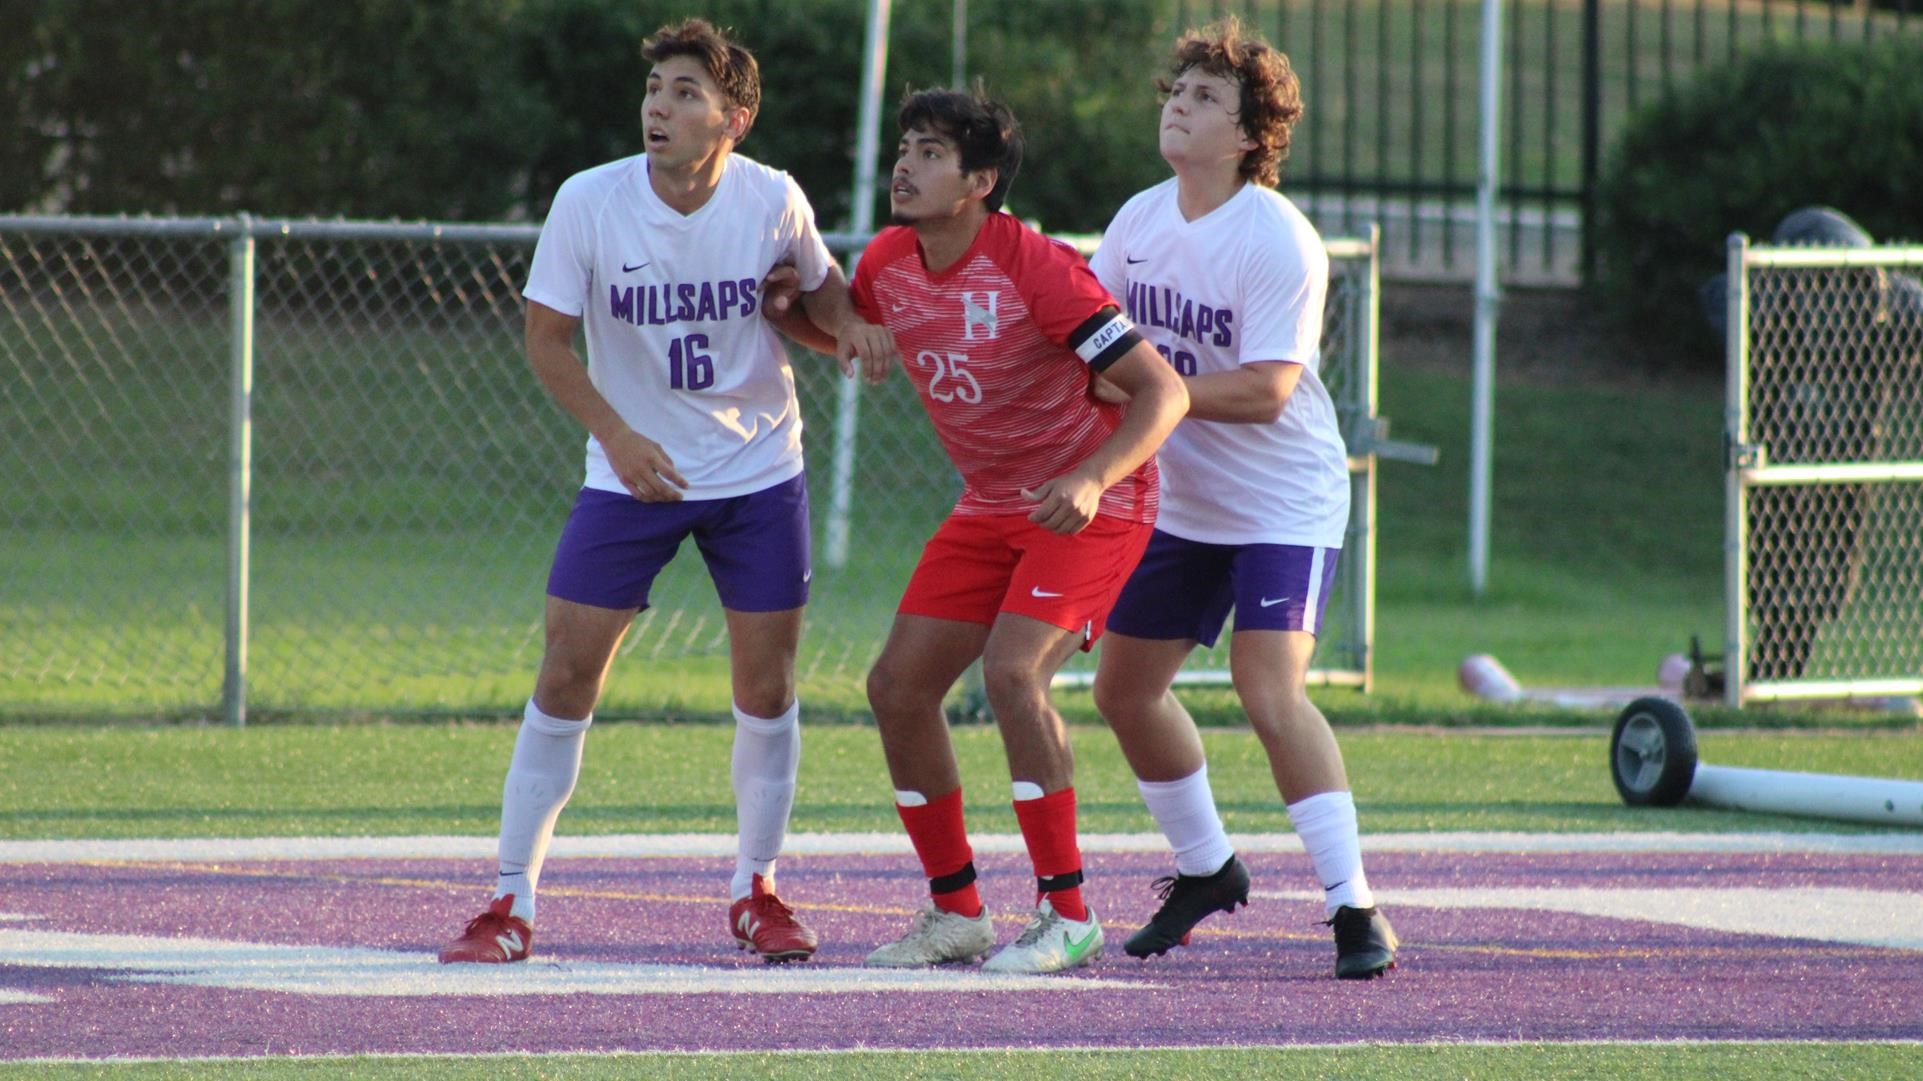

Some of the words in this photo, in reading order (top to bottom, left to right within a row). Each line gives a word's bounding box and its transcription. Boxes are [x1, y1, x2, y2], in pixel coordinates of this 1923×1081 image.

[610, 278, 757, 326] MILLSAPS
[668, 333, 714, 391] 16
[917, 350, 983, 404] 25
